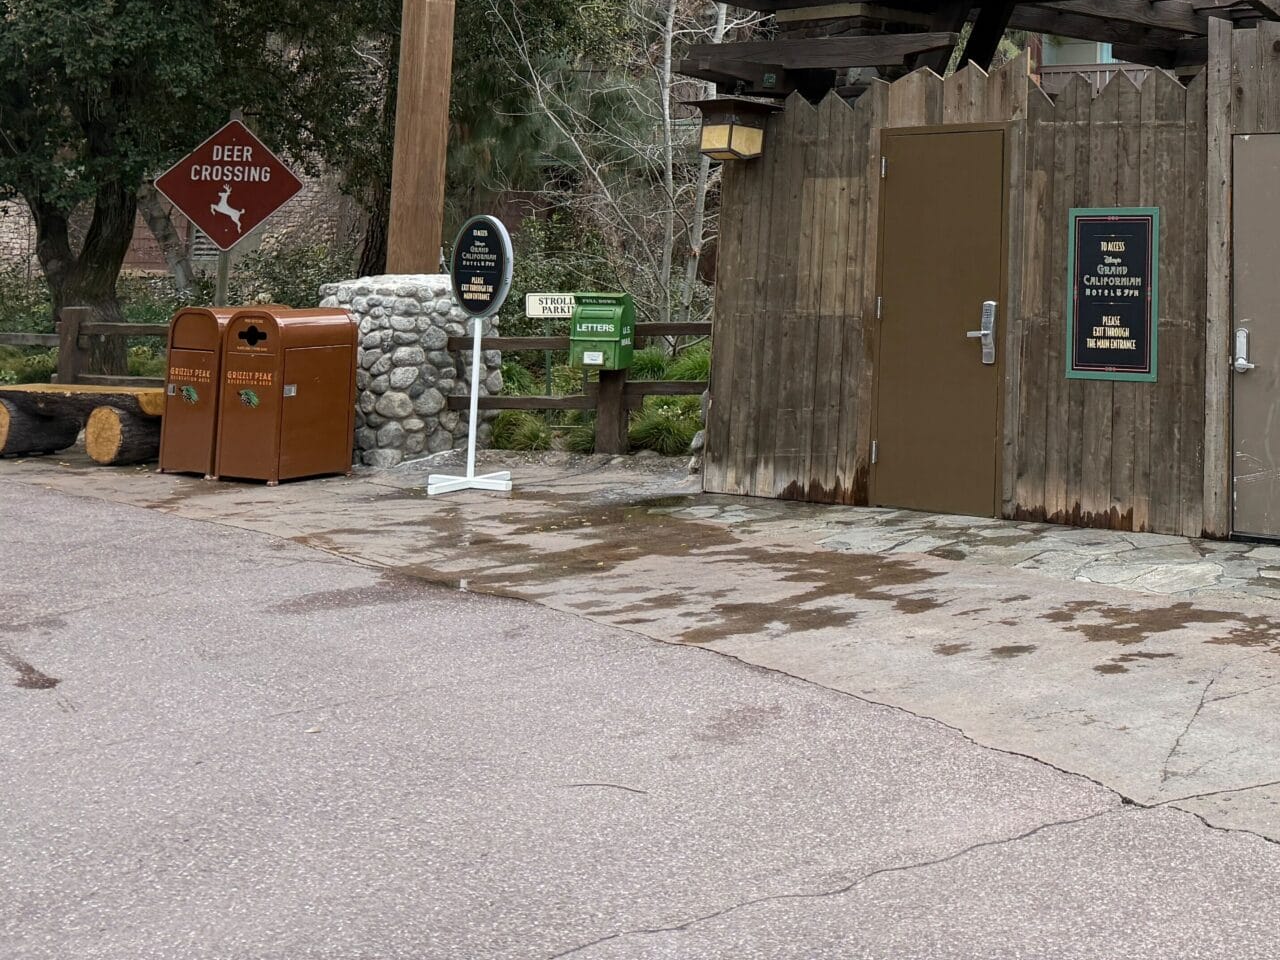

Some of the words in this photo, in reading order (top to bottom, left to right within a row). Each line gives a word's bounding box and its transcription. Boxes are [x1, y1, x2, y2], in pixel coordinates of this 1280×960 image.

[212, 145, 253, 162] DEER
[190, 165, 271, 182] CROSSING
[1101, 242, 1108, 251] TO
[1108, 242, 1125, 251] ACCESS
[1097, 264, 1128, 275] GRAND
[1083, 275, 1142, 286] CALIFORNIAN
[1085, 289, 1115, 297] HOTEL
[538, 297, 575, 305] STROLL
[542, 306, 572, 314] PARKI
[1102, 316, 1120, 326] PLEASE
[577, 323, 614, 331] LETTERS
[1093, 327, 1104, 337] EXIT
[1105, 328, 1129, 337] THROUGH
[1087, 338, 1096, 348] THE
[1096, 339, 1109, 348] MAIN
[1111, 340, 1136, 349] ENTRANCE
[170, 367, 193, 375] GRIZZLY
[194, 369, 210, 377] PEAK
[254, 372, 273, 380] PEAK
